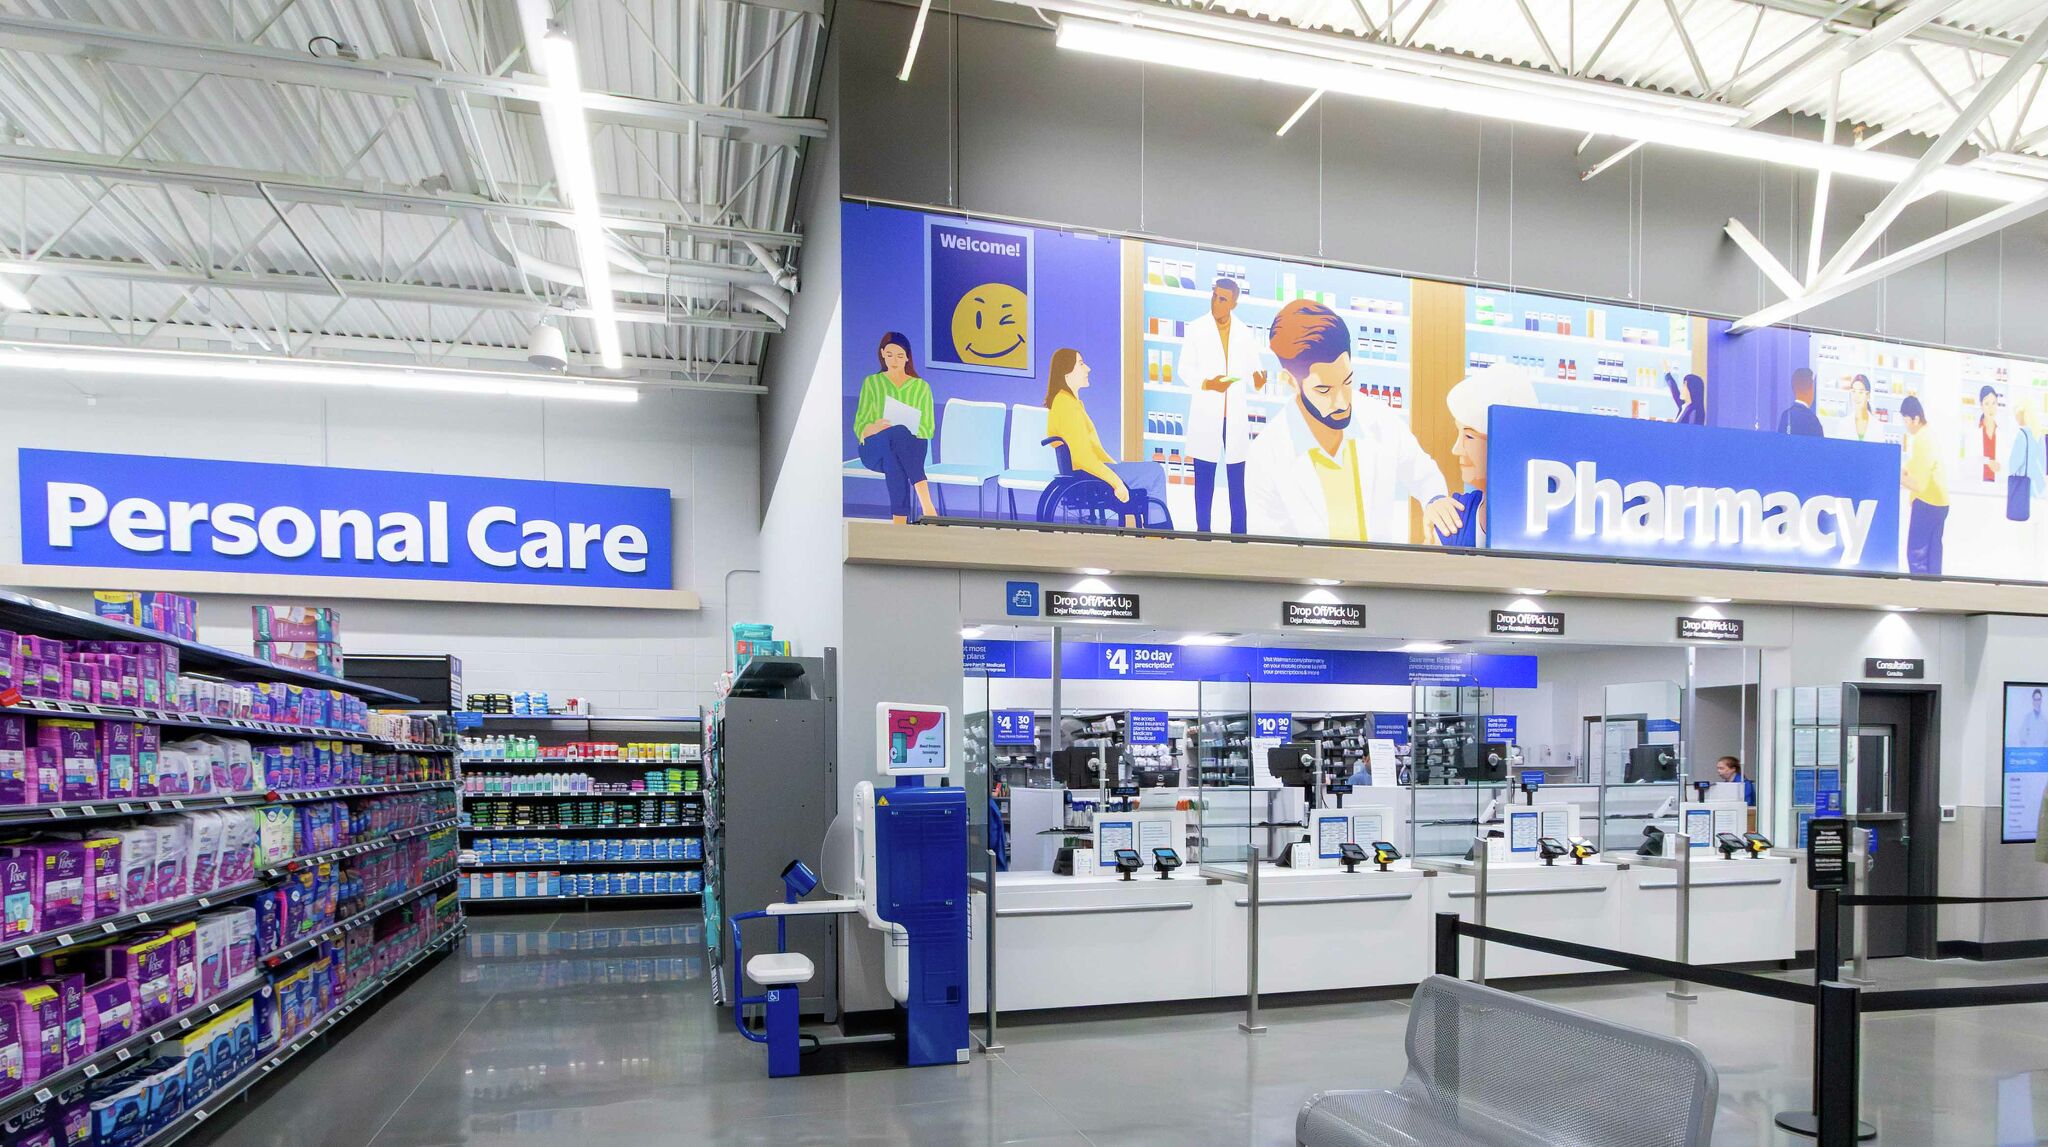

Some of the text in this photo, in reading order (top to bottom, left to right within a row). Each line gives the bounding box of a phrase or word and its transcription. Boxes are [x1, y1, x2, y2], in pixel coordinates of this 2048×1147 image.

[940, 233, 1020, 257] Welcome!
[1527, 458, 1879, 565] Pharmacy
[47, 481, 648, 573] Personal Care
[1053, 595, 1132, 610] Drop Off/Pick Up
[1053, 607, 1067, 615] Dejar
[1290, 605, 1360, 619] Drop Off/Pick Up
[1290, 616, 1303, 624] Dejar
[1496, 613, 1559, 627] Drop Off/Pick Up
[1682, 620, 1700, 631] Drop
[1728, 622, 1739, 633] Up
[1105, 648, 1129, 675] $4
[1134, 649, 1173, 663] 30 day
[1876, 660, 1914, 670] Consultation
[997, 715, 1030, 730] $4 30
[1257, 717, 1289, 731] $10 90
[113, 724, 129, 743] Poise
[143, 726, 156, 744] Poise
[70, 732, 89, 751] Poise
[57, 850, 77, 869] Poise
[7, 862, 27, 883] Poise
